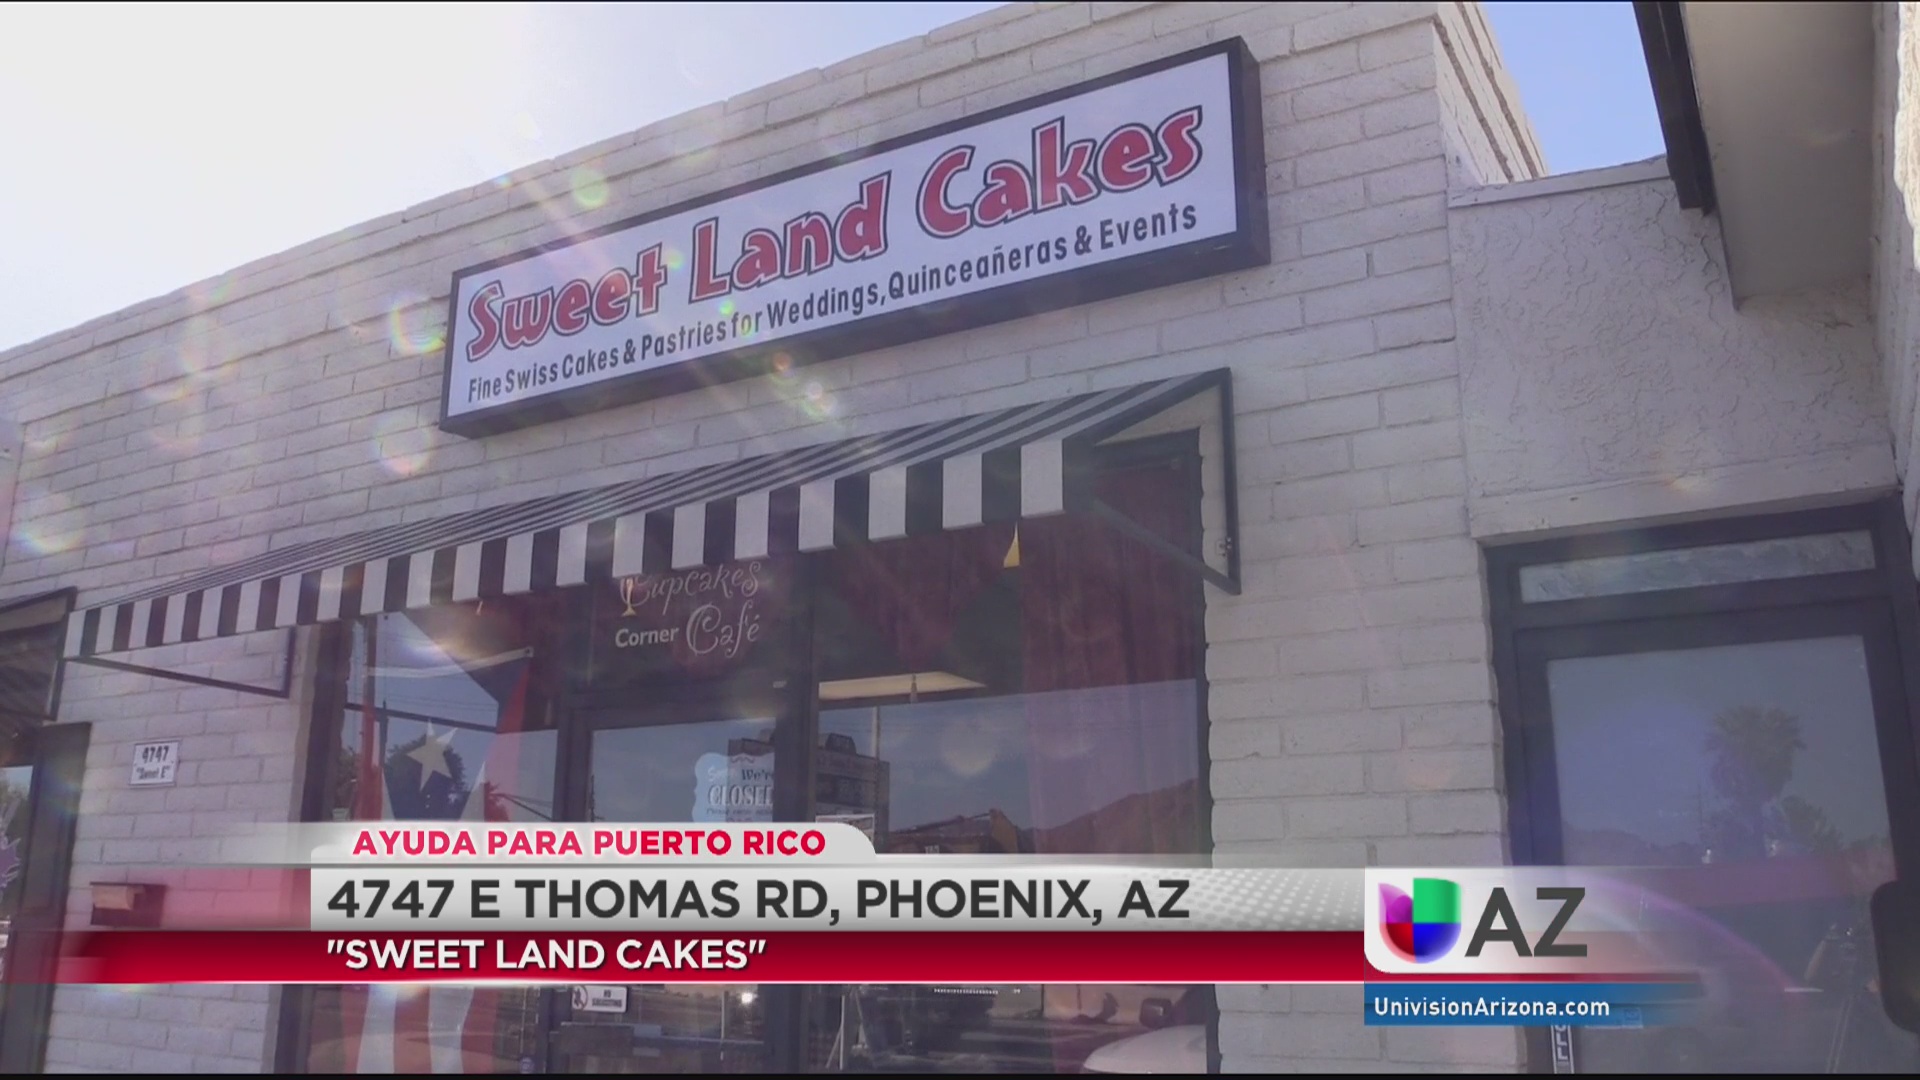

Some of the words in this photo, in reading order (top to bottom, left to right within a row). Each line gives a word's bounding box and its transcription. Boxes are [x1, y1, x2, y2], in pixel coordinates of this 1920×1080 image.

[466, 243, 667, 362] Sweet
[689, 170, 892, 304] Land
[916, 105, 1202, 238] Cakes
[468, 375, 501, 403] Fine
[505, 362, 558, 394] Swiss
[562, 346, 619, 379] Cakes
[623, 338, 636, 364] &
[641, 321, 727, 360] Pastries
[731, 311, 763, 339] for
[767, 281, 886, 328] Weddings,
[888, 235, 1067, 300] Quinceañeras
[1074, 225, 1092, 257] &
[1100, 202, 1197, 250] Events
[615, 627, 680, 648] Corner
[686, 600, 760, 658] Café
[141, 745, 169, 764] 4747
